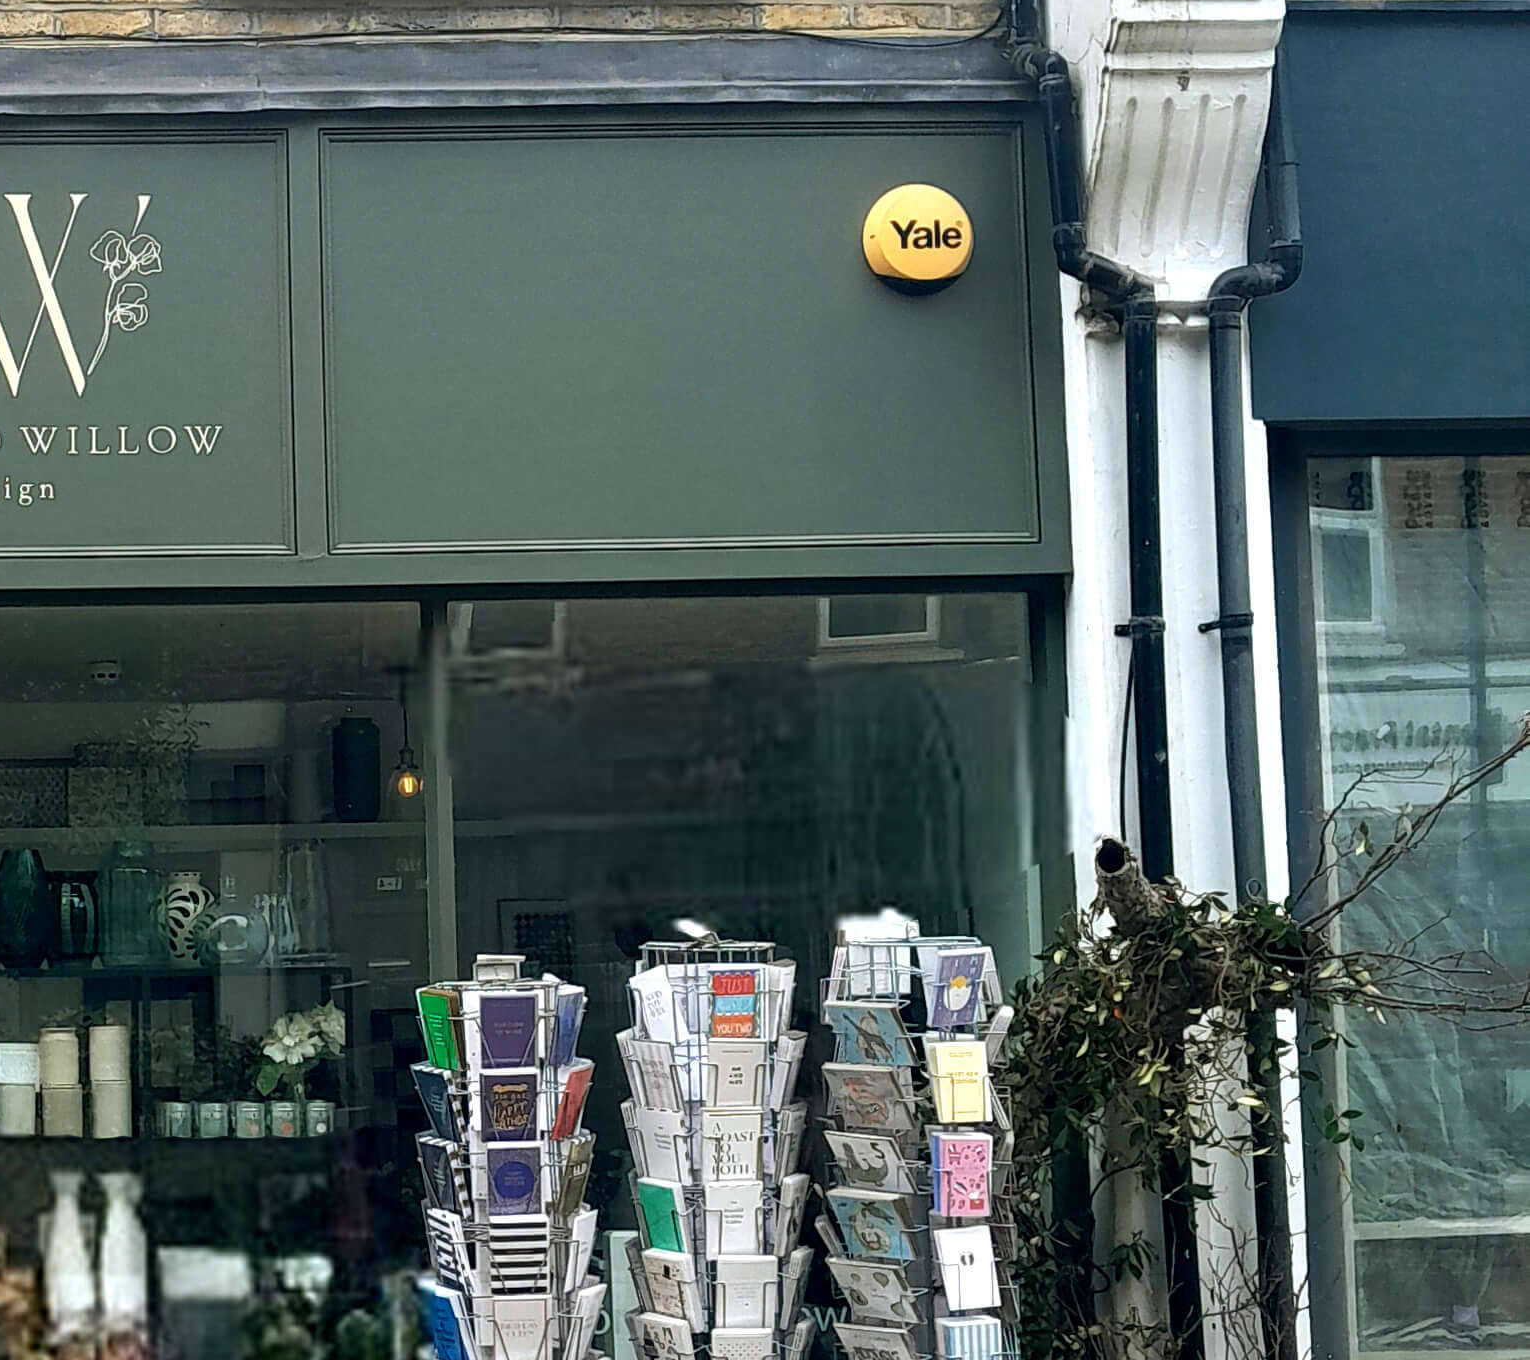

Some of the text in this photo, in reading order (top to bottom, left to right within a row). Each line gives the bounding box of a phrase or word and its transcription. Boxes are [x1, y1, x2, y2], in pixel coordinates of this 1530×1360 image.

[890, 219, 962, 249] Yale
[19, 424, 223, 455] WILLOW
[716, 1024, 732, 1034] YOU
